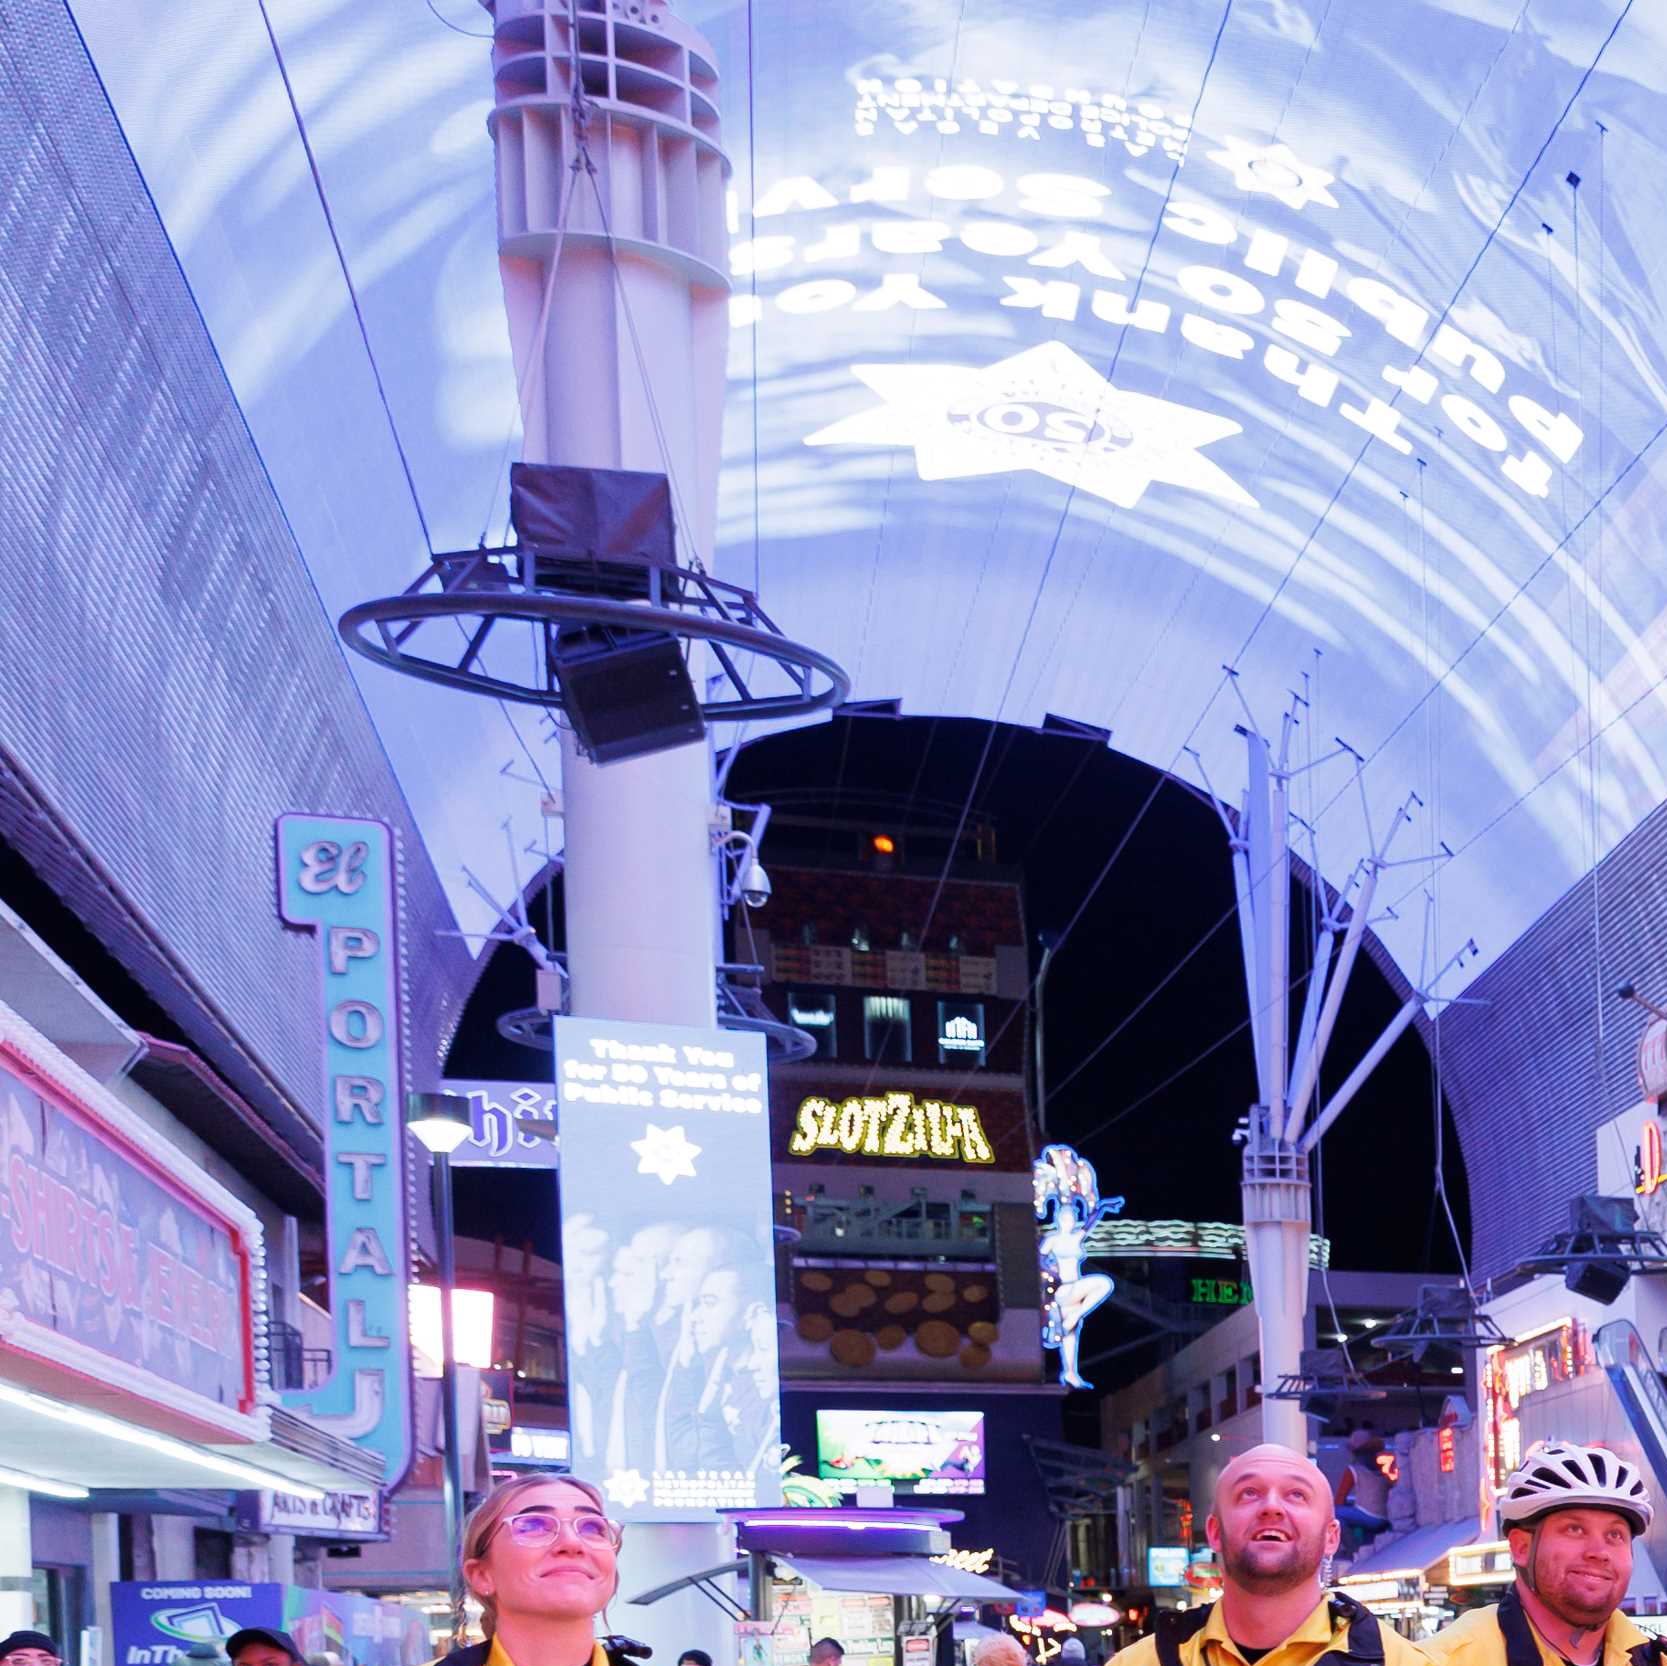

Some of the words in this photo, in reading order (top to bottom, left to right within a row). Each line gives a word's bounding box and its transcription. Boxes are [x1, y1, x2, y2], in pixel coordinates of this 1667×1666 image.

[298, 841, 368, 894] El
[590, 1039, 677, 1063] Thank
[683, 1046, 734, 1068] You
[563, 1059, 607, 1080] for
[611, 1063, 648, 1083] 50
[654, 1066, 727, 1089] Years
[731, 1073, 761, 1093] of
[563, 1082, 653, 1107] Public
[659, 1089, 762, 1114] Service
[327, 926, 392, 1349] PORTAL
[790, 1092, 994, 1162] SLOTZILLA
[141, 1587, 200, 1600] COMING
[203, 1586, 252, 1599] SOON!
